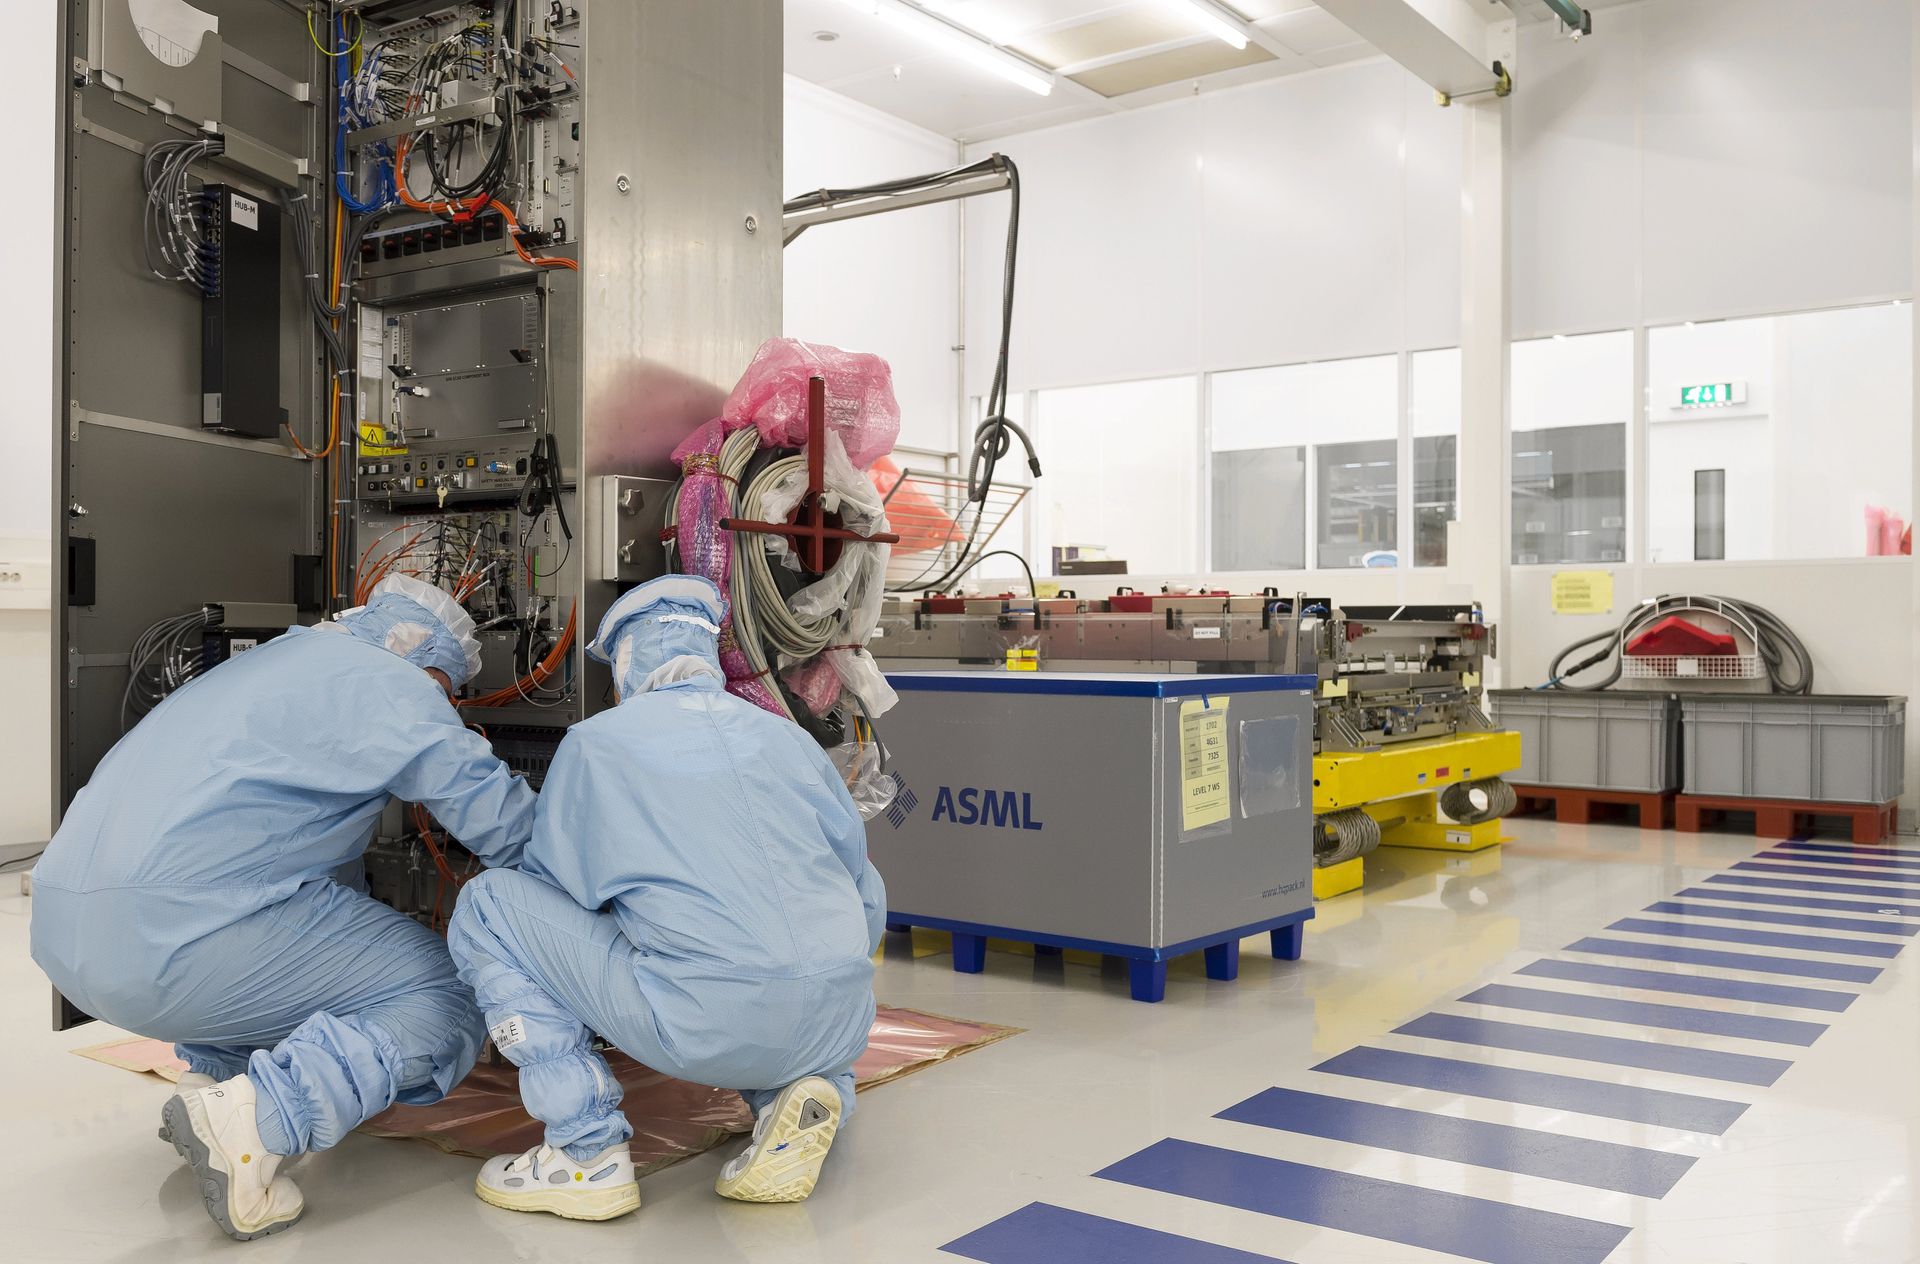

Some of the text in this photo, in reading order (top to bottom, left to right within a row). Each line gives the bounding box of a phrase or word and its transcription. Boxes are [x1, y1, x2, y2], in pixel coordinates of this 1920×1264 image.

[1193, 786, 1207, 796] LEVEL
[931, 785, 1043, 831] ASML
[510, 1024, 518, 1036] E
